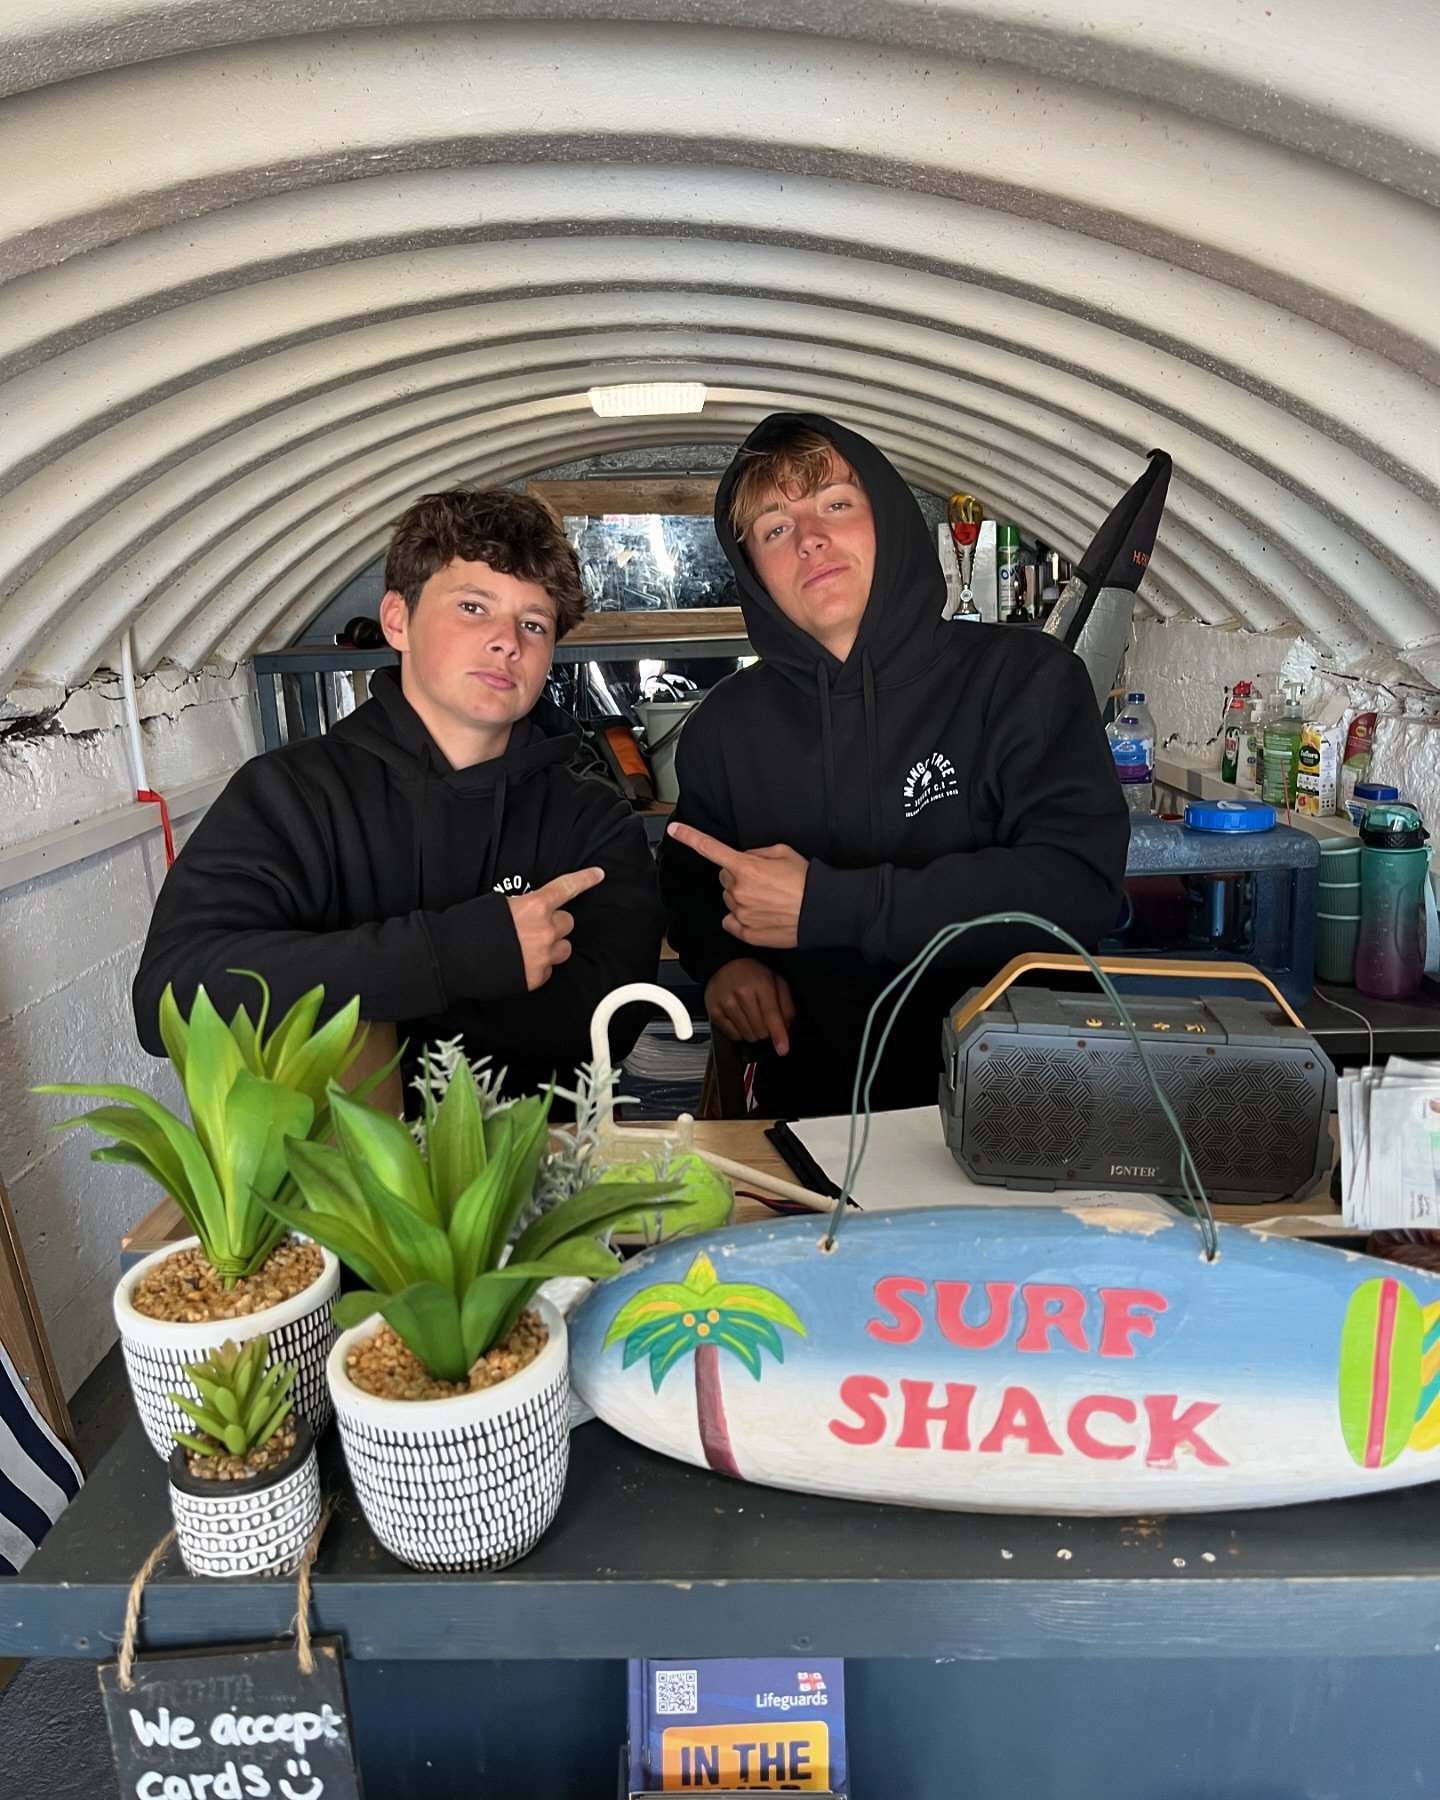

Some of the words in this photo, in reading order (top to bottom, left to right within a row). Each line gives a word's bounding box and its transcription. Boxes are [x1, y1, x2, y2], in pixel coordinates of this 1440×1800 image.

[931, 752, 955, 778] TREE
[866, 1276, 1169, 1358] SURF
[828, 1375, 1230, 1469] SHACK
[756, 1692, 828, 1711] Lifeguards
[129, 1707, 201, 1749] We
[210, 1704, 342, 1754] accept
[681, 1745, 719, 1786] IN
[733, 1740, 812, 1782] THE
